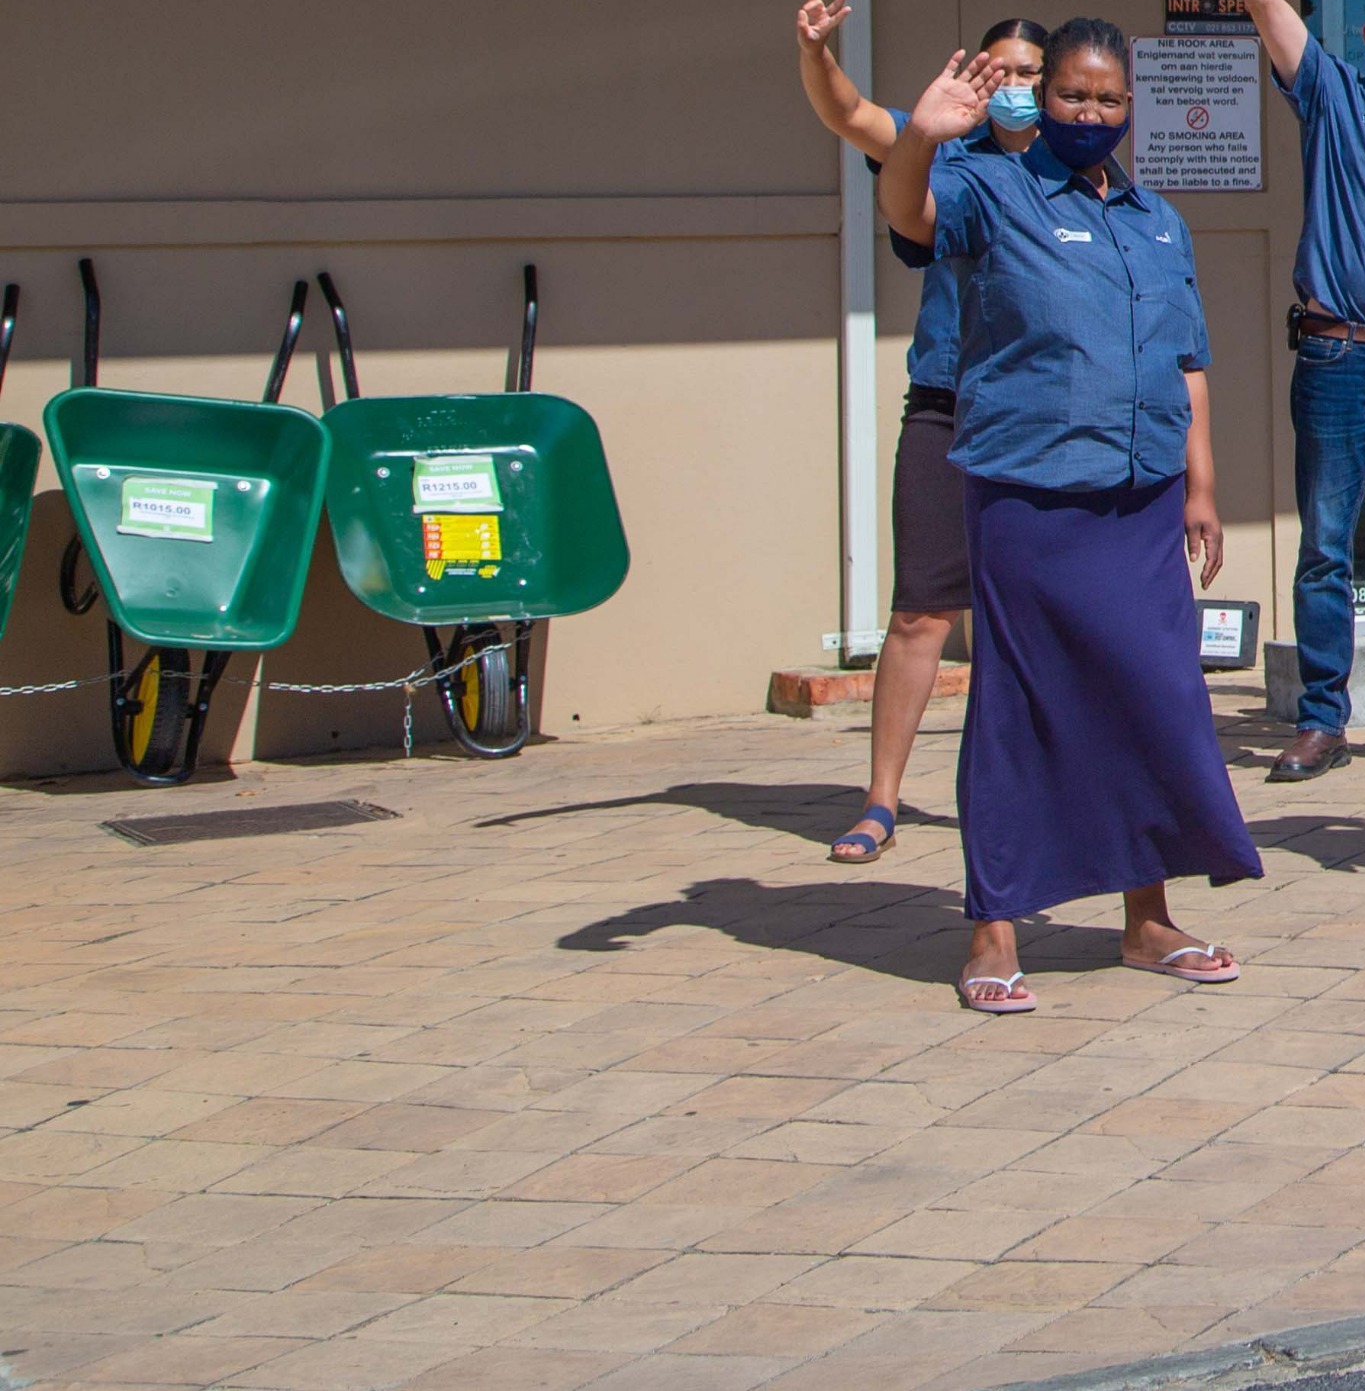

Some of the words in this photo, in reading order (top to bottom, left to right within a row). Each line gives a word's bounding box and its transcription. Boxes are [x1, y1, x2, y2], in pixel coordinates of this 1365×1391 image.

[1168, 22, 1196, 32] CCTV
[1158, 39, 1175, 48] NIE
[1178, 39, 1207, 48] ROOK
[1209, 39, 1235, 48] AREA
[1198, 51, 1216, 60] wat
[1161, 63, 1177, 71] om
[1180, 63, 1198, 71] aan
[1201, 62, 1233, 71] hierdie
[1136, 74, 1203, 84] kennisgewing
[1206, 74, 1215, 83] te
[1151, 86, 1165, 94] sal
[1206, 86, 1230, 94] word
[1156, 97, 1174, 106] kan
[1177, 97, 1210, 106] beboet
[1150, 131, 1166, 140] NO
[1168, 131, 1217, 140] SMOKING
[1219, 131, 1245, 140] AREA
[1148, 143, 1166, 153] Any
[1169, 144, 1202, 153] person
[1205, 143, 1225, 151] who
[1227, 143, 1248, 151] fails
[1135, 155, 1145, 163] to
[1148, 155, 1184, 165] comply
[1187, 155, 1207, 163] with
[1210, 155, 1228, 163] this
[1230, 155, 1260, 163] notice
[1140, 166, 1163, 175] shall
[1166, 166, 1178, 175] be
[1181, 166, 1236, 177] prosecuted
[1238, 166, 1256, 175] and
[1143, 179, 1164, 188] may
[1167, 178, 1179, 187] be
[1182, 178, 1208, 187] liable
[1212, 178, 1221, 186] to
[422, 481, 477, 492] R1215.00
[133, 501, 191, 515] R1015.00
